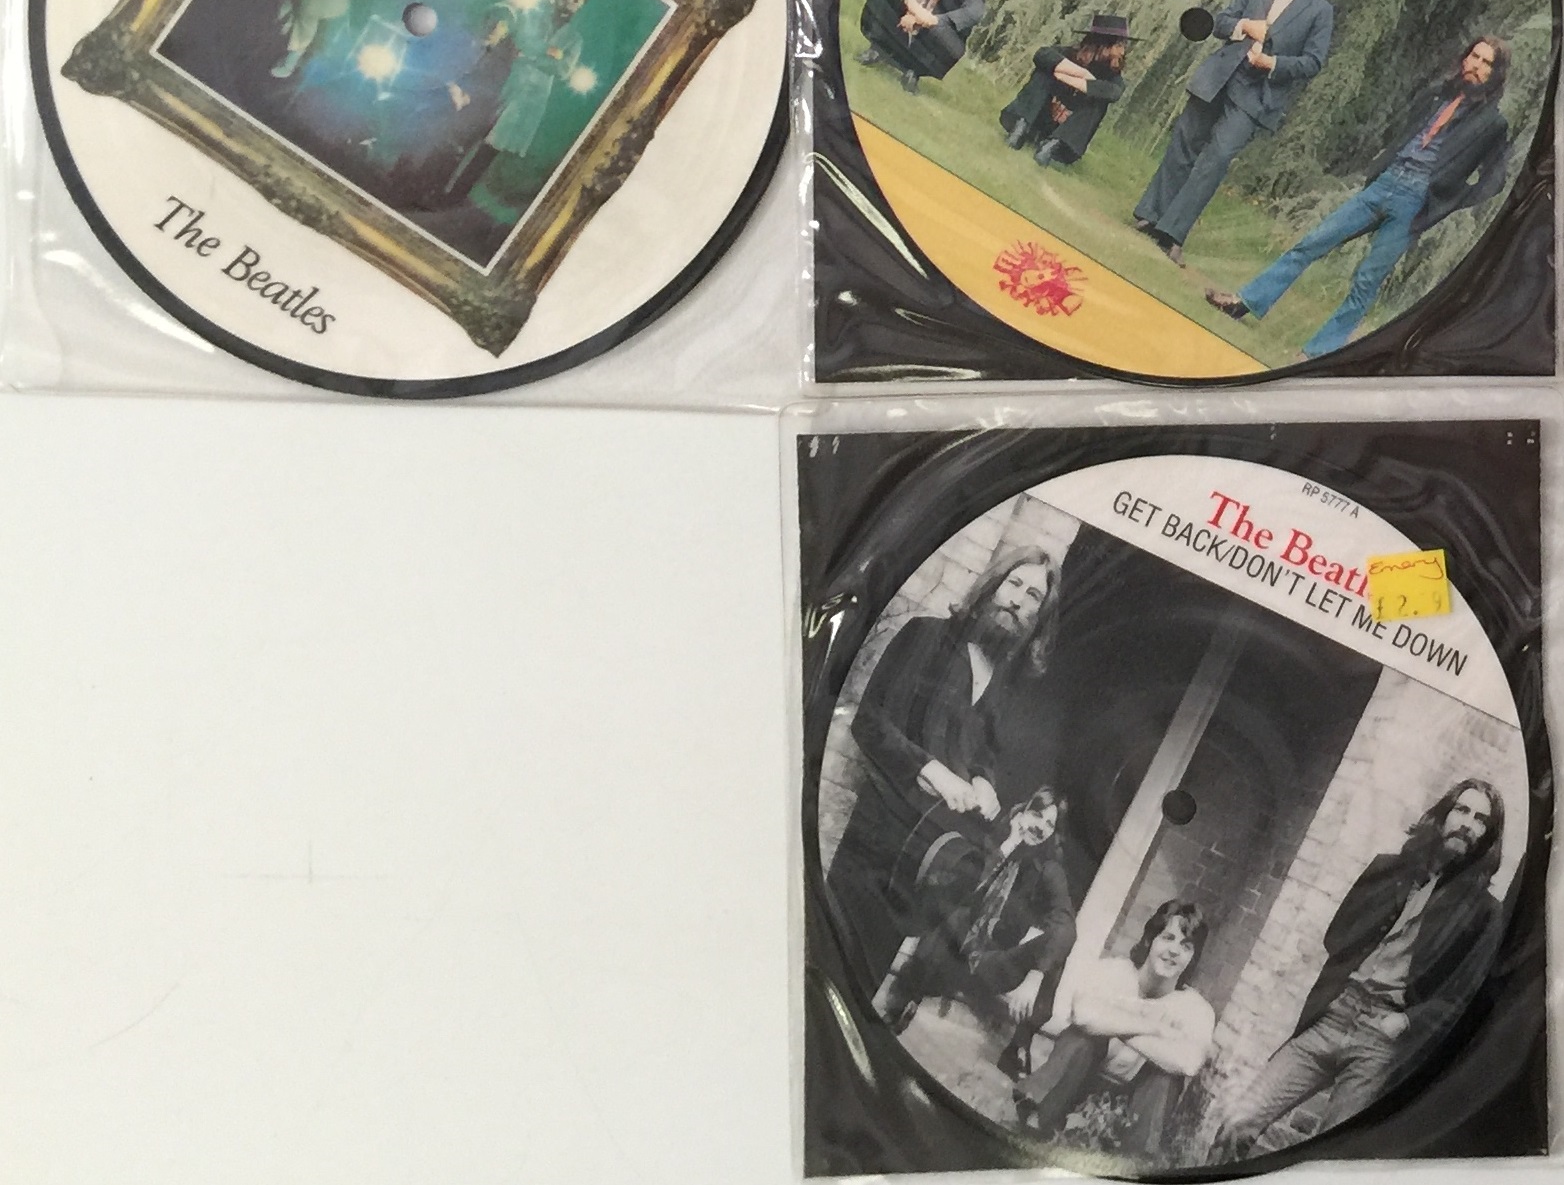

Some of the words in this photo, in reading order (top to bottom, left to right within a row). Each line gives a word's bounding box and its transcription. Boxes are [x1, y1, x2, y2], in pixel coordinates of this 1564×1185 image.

[154, 195, 221, 258] The
[221, 244, 336, 334] Beatles
[1206, 490, 1274, 550] The
[1280, 528, 1370, 598] Beatl
[1301, 481, 1320, 497] RP
[1320, 491, 1350, 513] 5777
[1349, 505, 1360, 519] A
[1112, 490, 1163, 527] GET
[1305, 582, 1353, 618] LET
[1352, 604, 1389, 640] ME
[1391, 624, 1470, 677] DOWN
